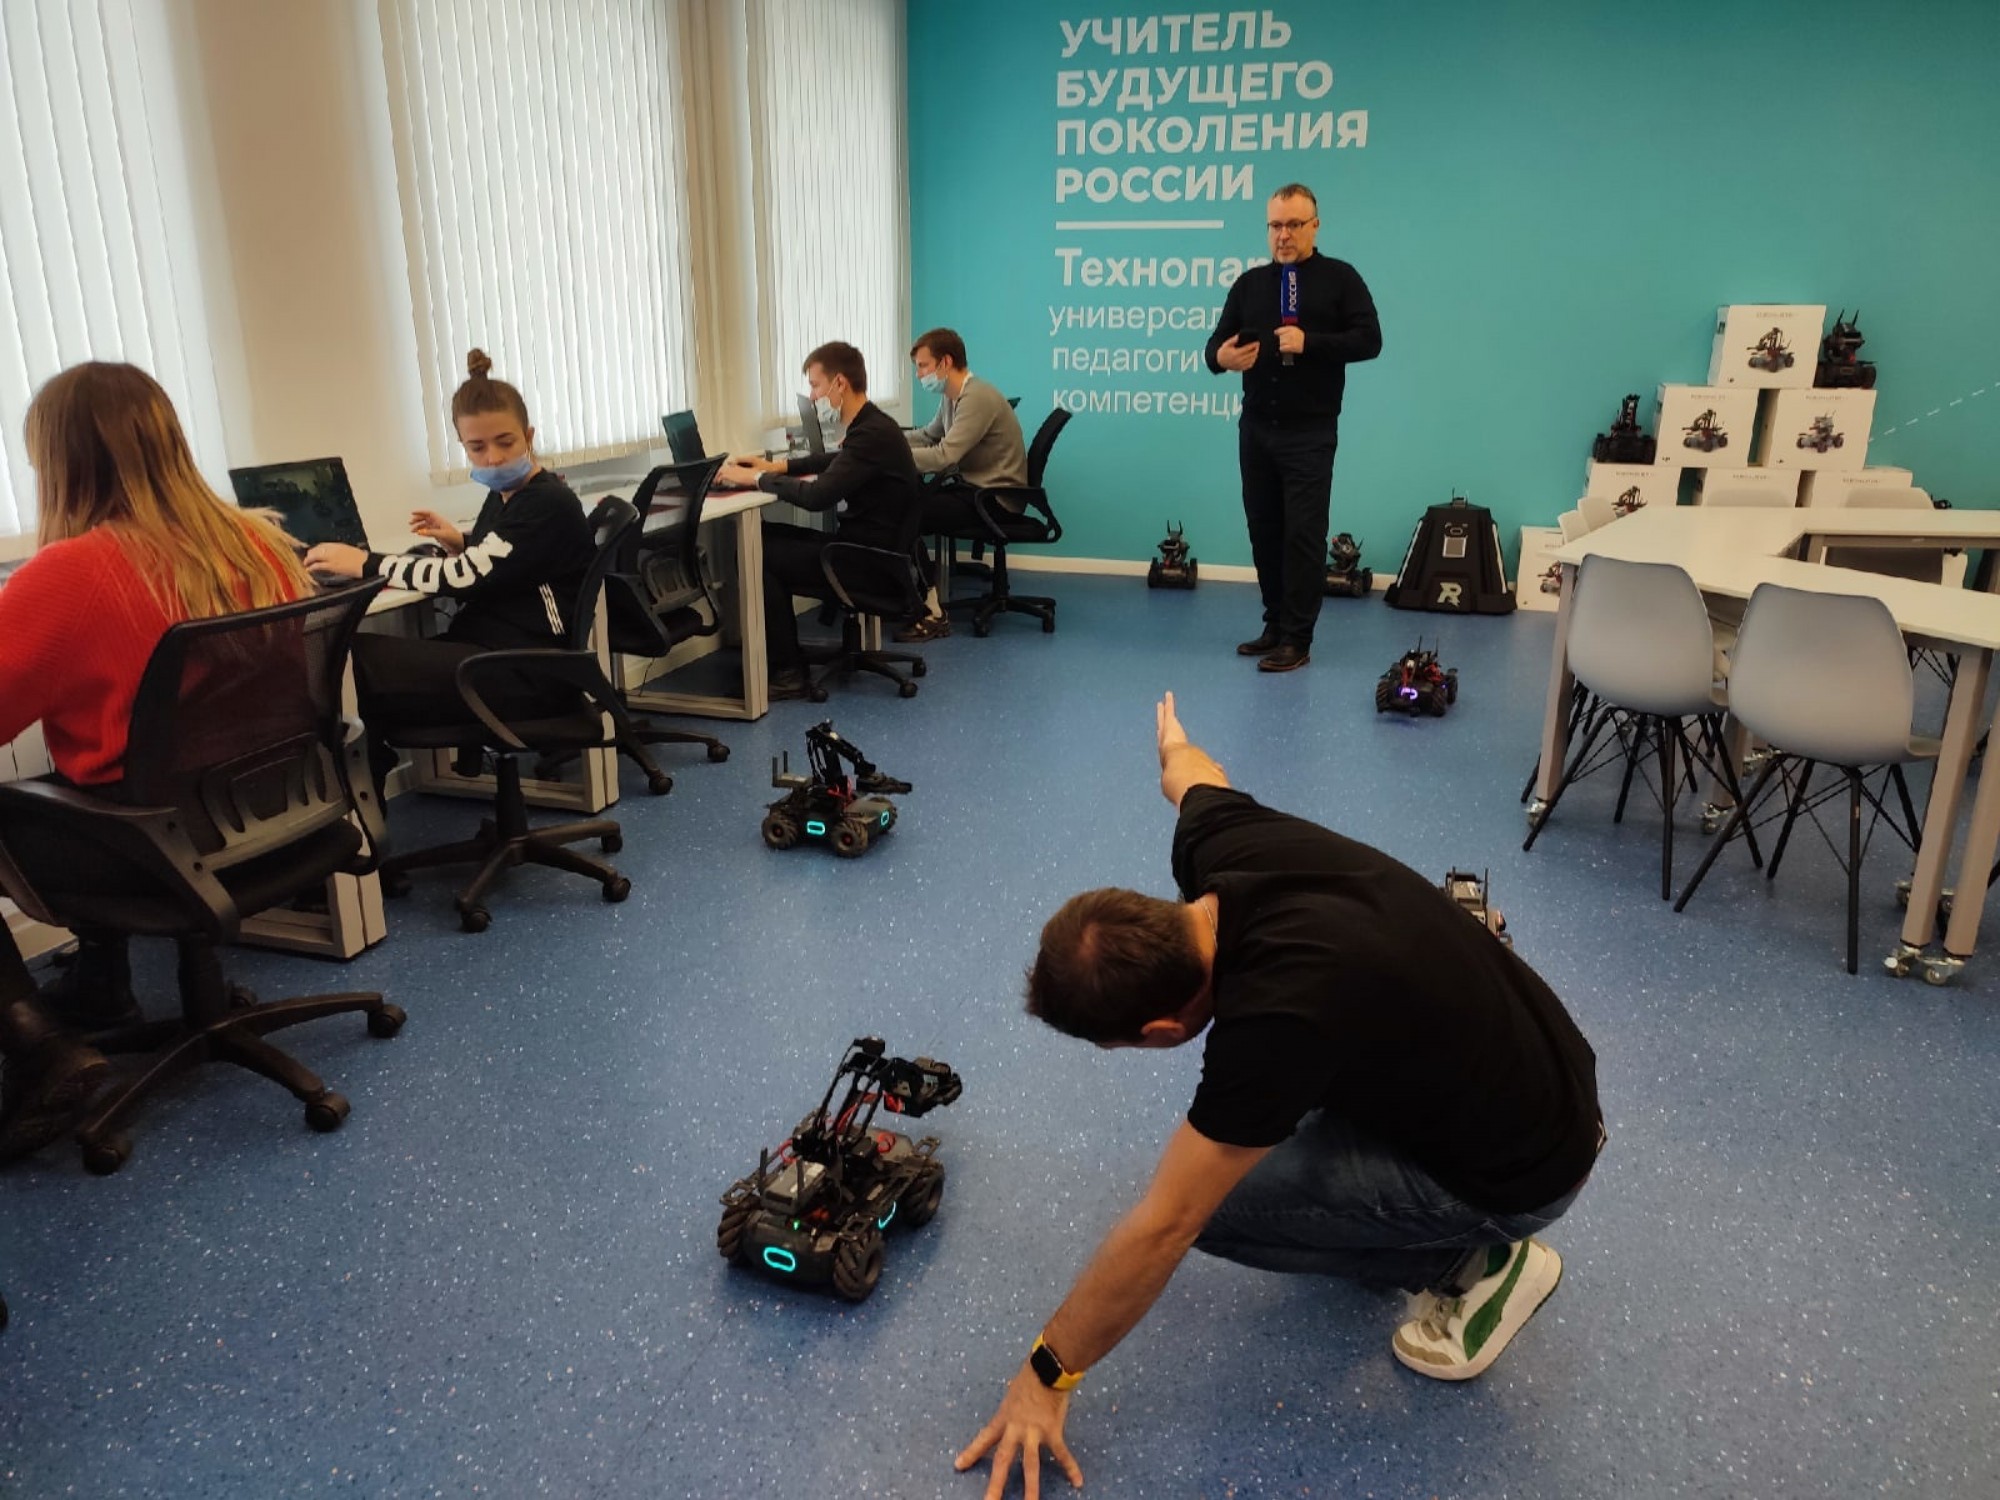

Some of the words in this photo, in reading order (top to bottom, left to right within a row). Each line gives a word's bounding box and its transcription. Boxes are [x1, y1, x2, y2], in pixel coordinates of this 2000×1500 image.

[1060, 10, 1292, 58] УЧИТЕЛЬ
[1056, 60, 1334, 112] БУДУЩЕГО
[1056, 109, 1369, 156] ПОКОЛЕНИЯ
[1055, 163, 1254, 204] РОССИИ
[1051, 347, 1206, 376] педагоги
